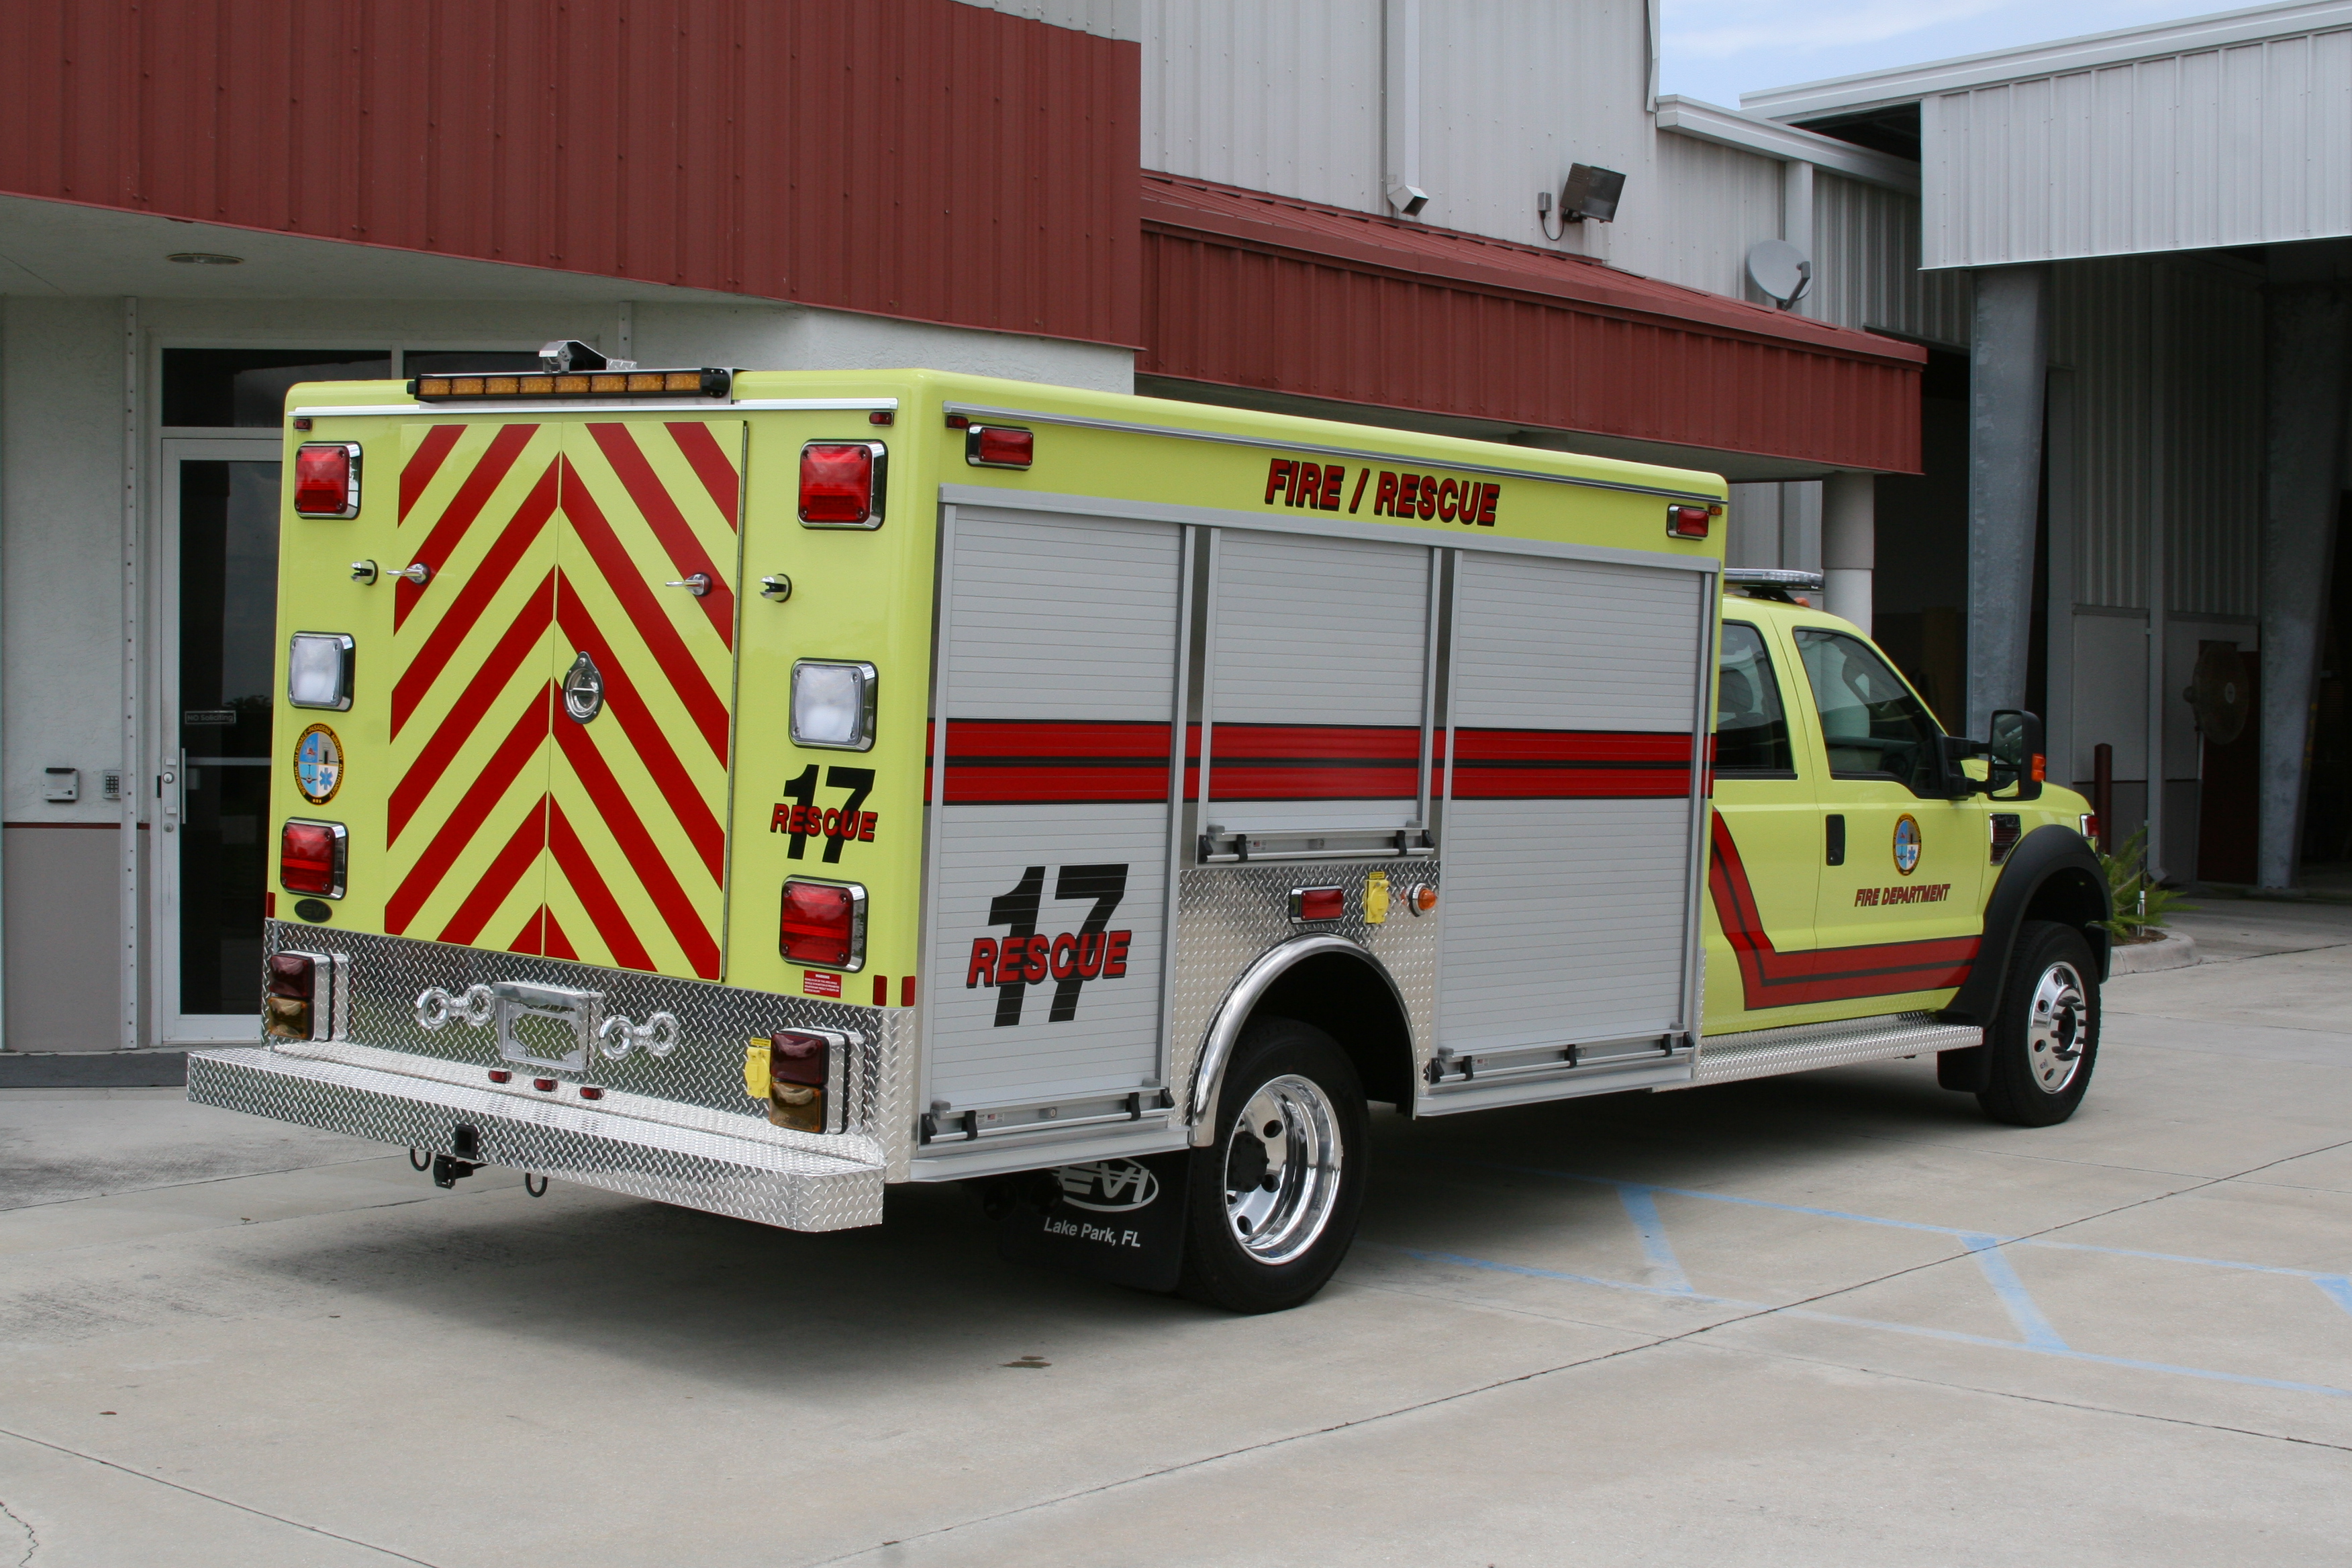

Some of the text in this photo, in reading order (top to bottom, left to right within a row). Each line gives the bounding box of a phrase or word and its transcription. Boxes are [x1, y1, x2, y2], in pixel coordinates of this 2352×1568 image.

[1265, 458, 1500, 527] FIRE / RESCUE
[201, 714, 234, 722] Soliciting
[770, 803, 878, 842] RESCUE
[783, 764, 876, 863] 17
[1854, 884, 1951, 907] FIRE DEPARTMENT
[967, 930, 1132, 989] RESCUE
[988, 864, 1129, 1027] 17
[1044, 1217, 1141, 1247] Lake Park, FL
